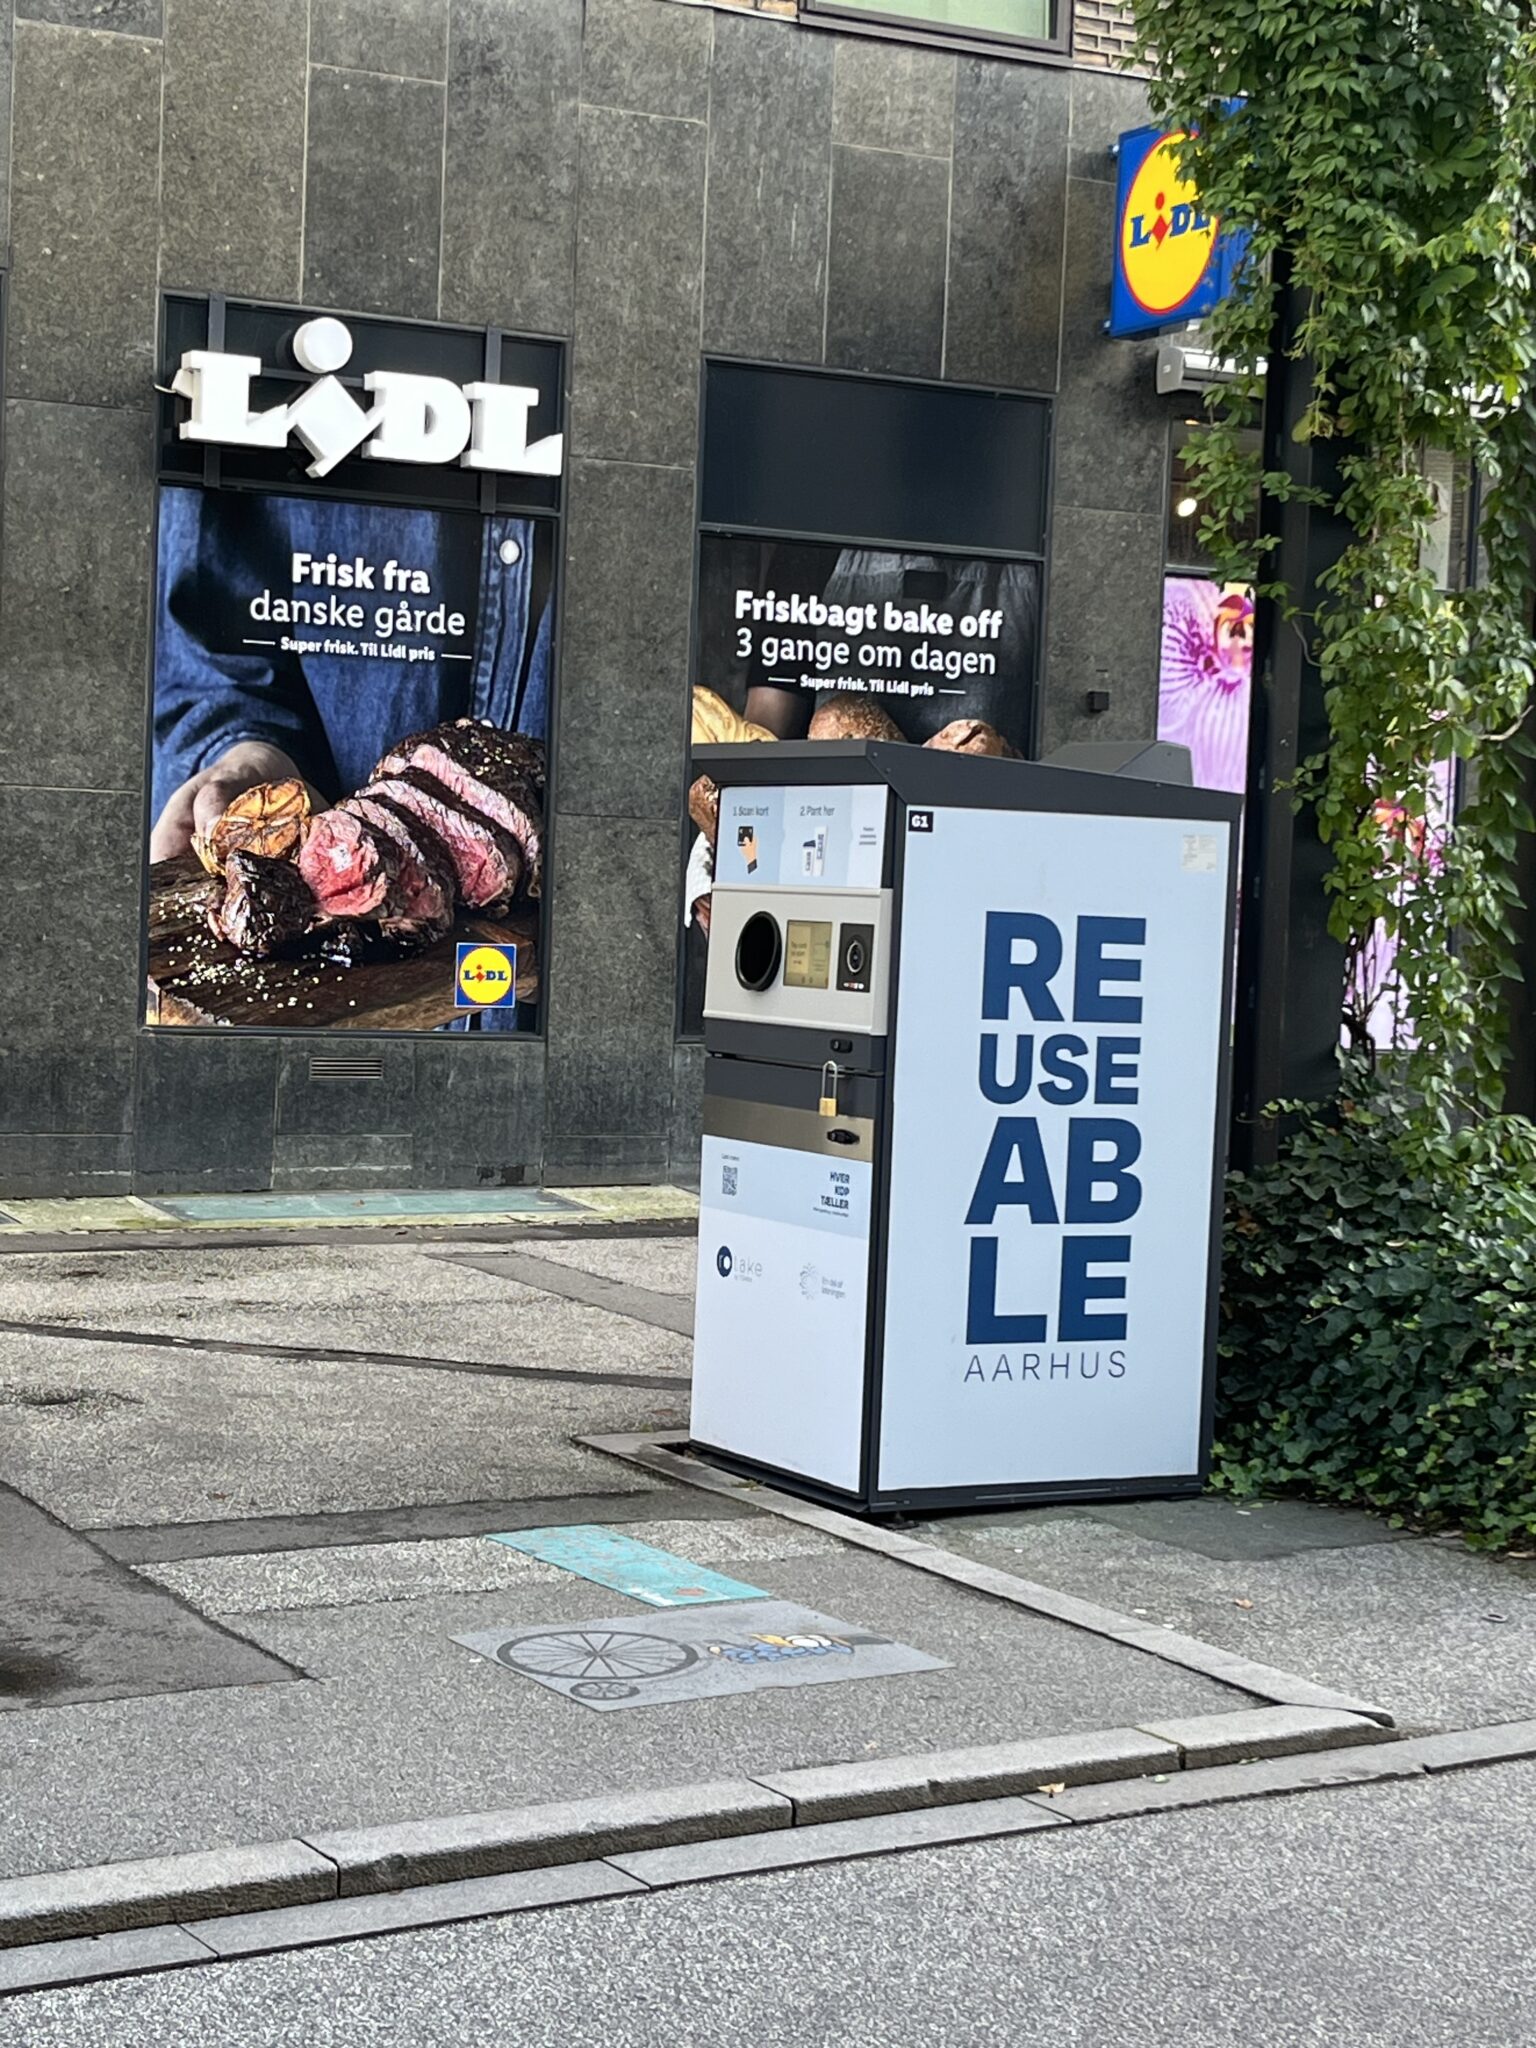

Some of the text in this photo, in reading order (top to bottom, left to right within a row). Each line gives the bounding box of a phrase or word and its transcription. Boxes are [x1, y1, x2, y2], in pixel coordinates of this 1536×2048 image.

[292, 552, 431, 594] Frisk fra
[249, 589, 466, 638] danske gårde
[734, 589, 1004, 639] Friskbagt bake off
[280, 636, 436, 663] Super frisk. Til Lidl pris
[735, 627, 996, 680] 3 gange om dagen
[799, 673, 934, 698] Super frisk. Til Lidl pris
[911, 815, 929, 829] G1
[981, 911, 1147, 1024] RE
[978, 1033, 1142, 1105] USE
[829, 1171, 850, 1184] HVER
[834, 1185, 850, 1196] KOP
[963, 1116, 1143, 1225] AB
[820, 1195, 849, 1209] TÆLLER
[965, 1234, 1132, 1345] LE
[963, 1350, 1127, 1382] AARHUS
